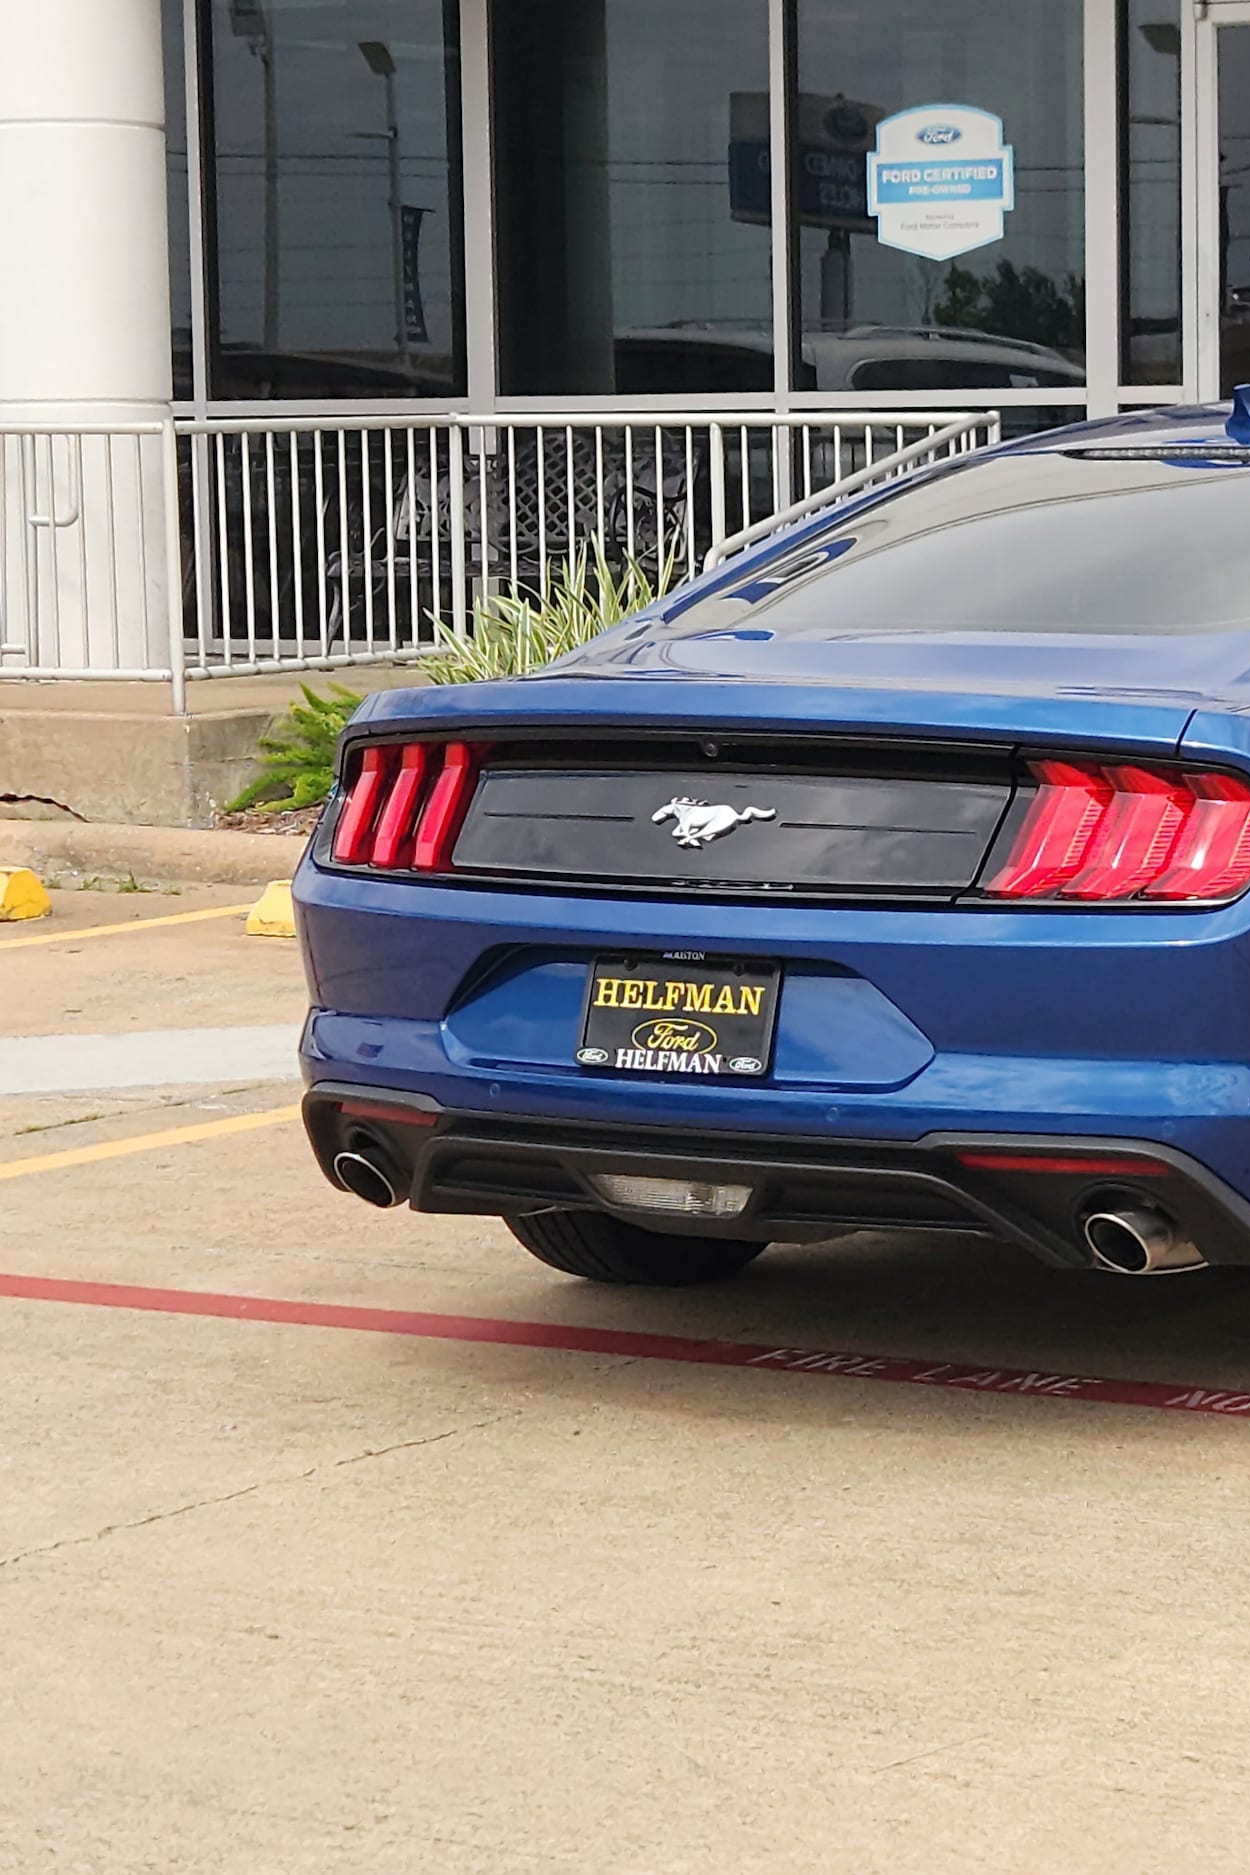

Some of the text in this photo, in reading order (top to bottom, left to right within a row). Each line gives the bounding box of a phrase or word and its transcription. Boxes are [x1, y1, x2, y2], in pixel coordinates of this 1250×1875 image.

[923, 128, 954, 143] Ford
[882, 166, 998, 184] FORD CERTIFIED
[593, 978, 766, 1016] HELFMAN
[647, 1023, 701, 1051] Ford
[615, 1048, 722, 1075] HELFMAN
[746, 1349, 909, 1375] FIRE
[913, 1364, 1103, 1396] LANE
